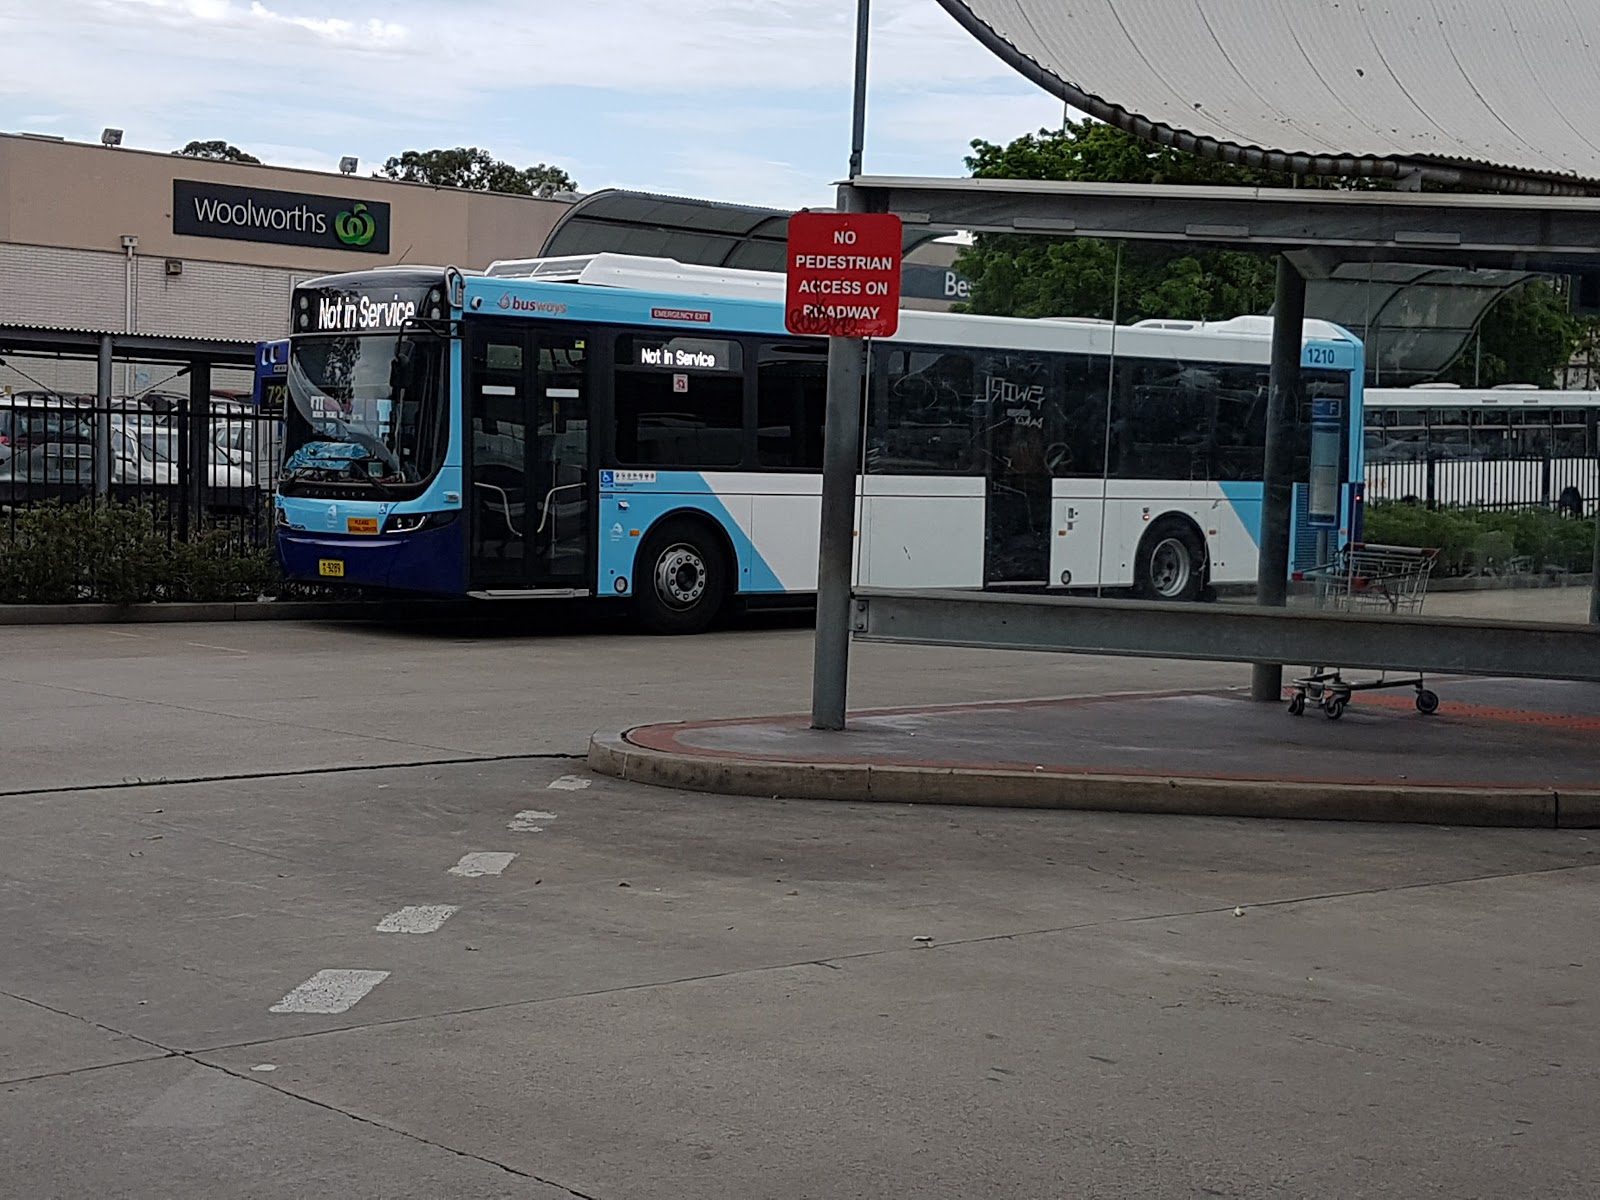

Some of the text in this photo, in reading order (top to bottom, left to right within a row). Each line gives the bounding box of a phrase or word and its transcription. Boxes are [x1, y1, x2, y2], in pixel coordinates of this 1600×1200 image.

[194, 197, 327, 234] Woolworths
[833, 230, 857, 245] NO
[795, 254, 893, 271] PEDESTRIAN
[798, 279, 888, 296] ACCESS ON
[318, 294, 415, 330] Not in Service
[512, 295, 568, 317] busways
[802, 304, 880, 320] ROADWAY
[653, 309, 709, 321] EMERGENCY EXIT
[641, 347, 716, 368] Not in Service
[1307, 347, 1335, 364] 1210
[1329, 401, 1338, 415] F
